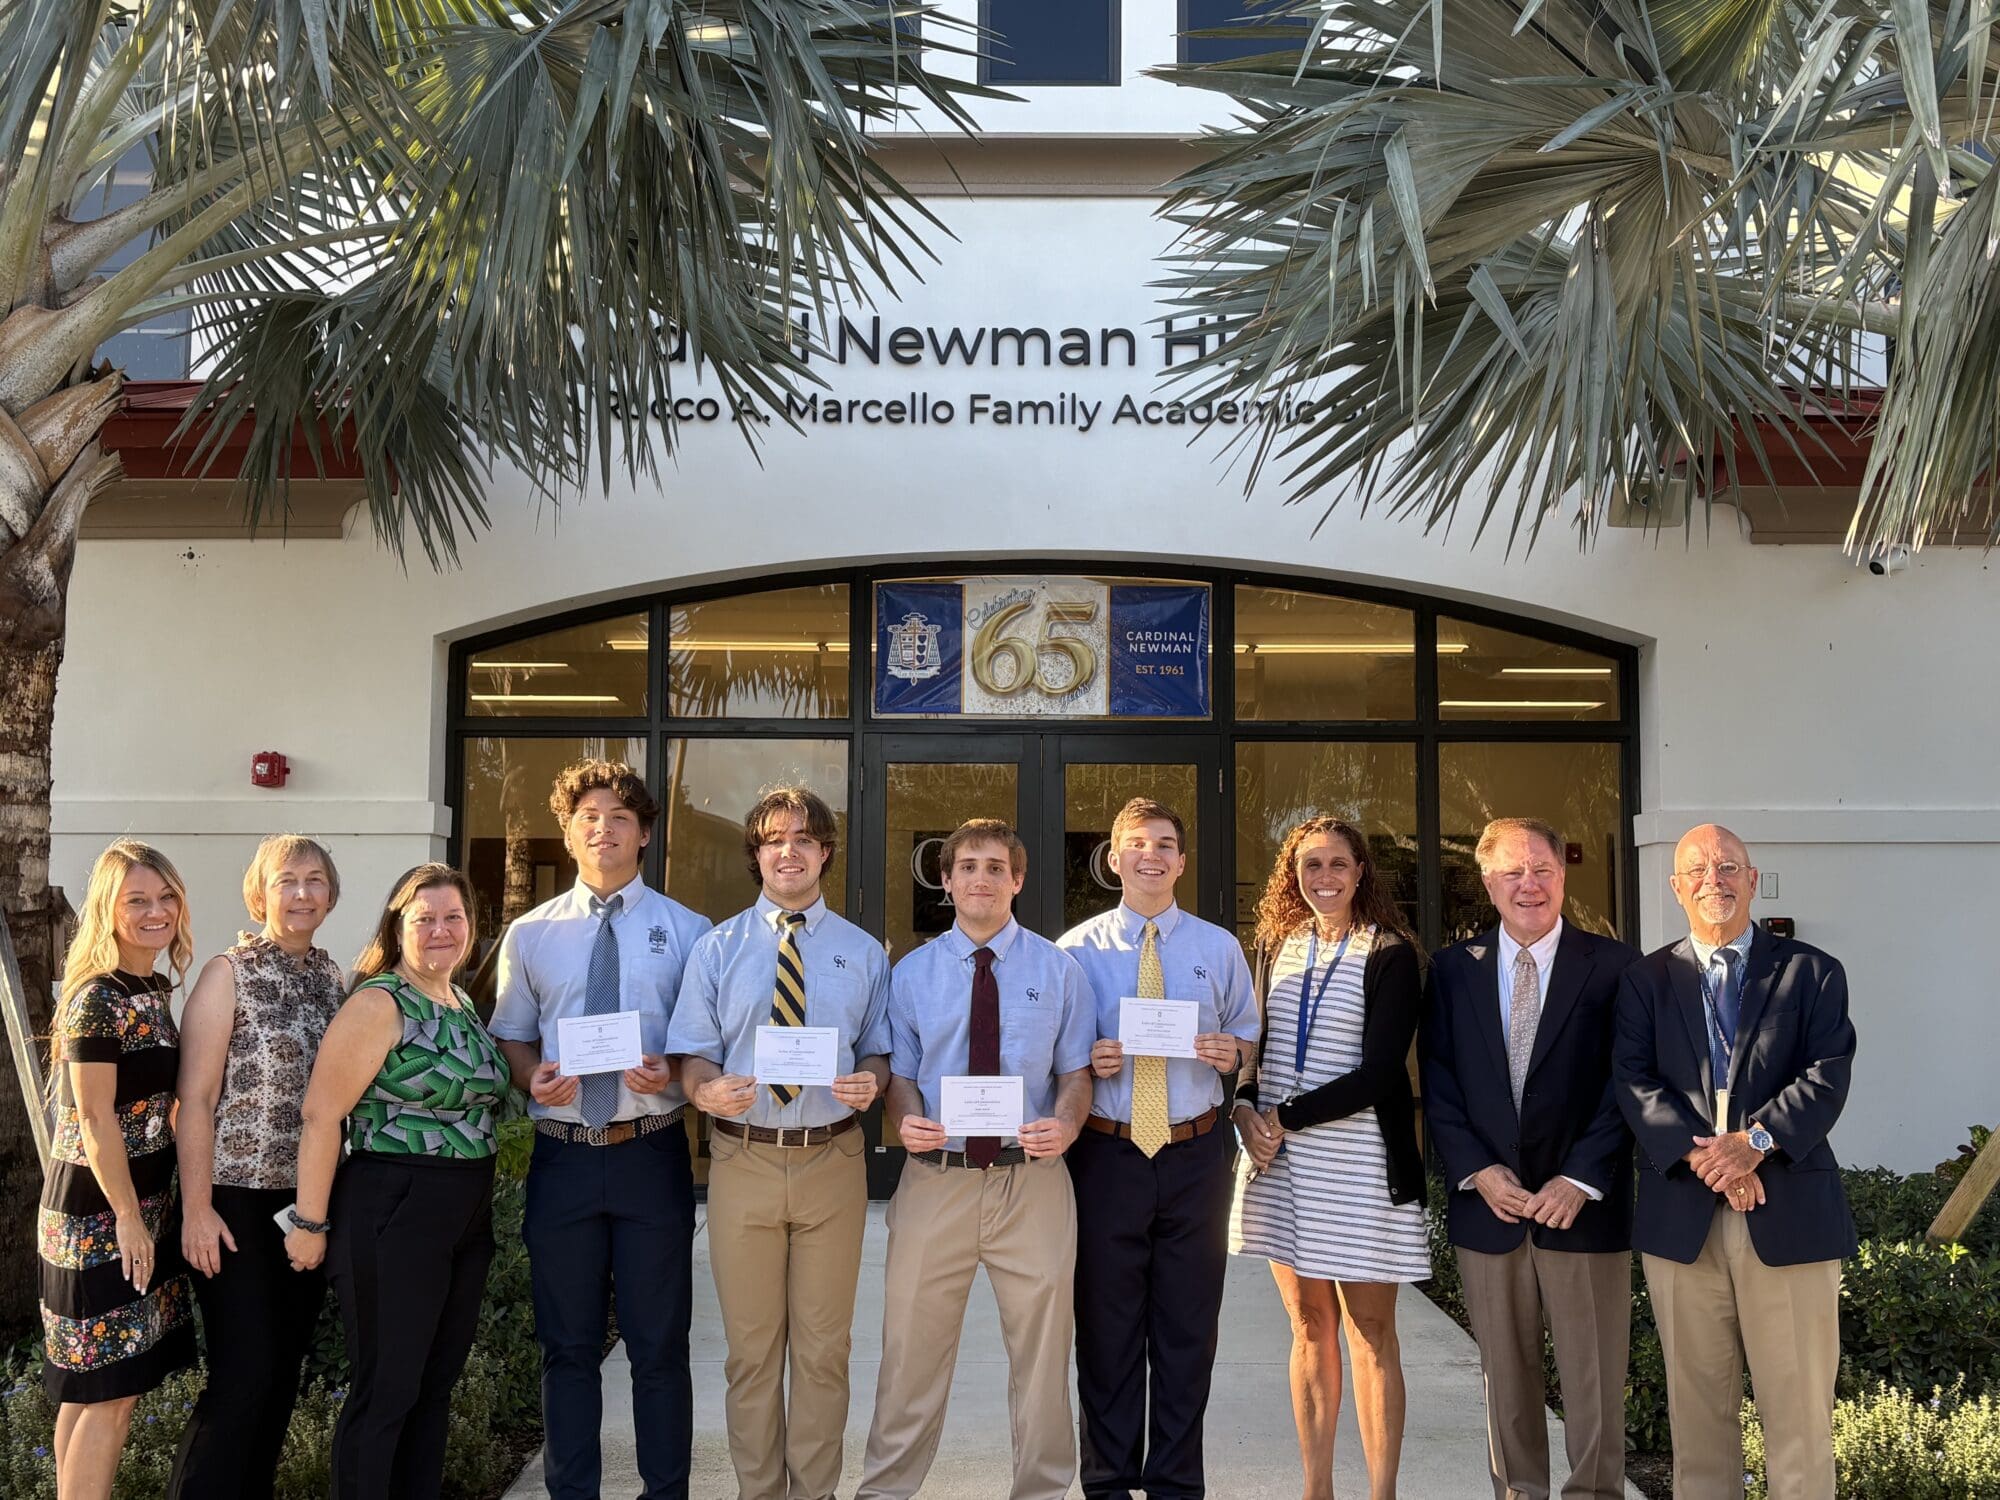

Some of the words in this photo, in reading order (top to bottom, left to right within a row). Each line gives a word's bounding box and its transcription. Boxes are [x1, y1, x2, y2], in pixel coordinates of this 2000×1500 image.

[837, 314, 1136, 367] Newman
[731, 392, 771, 424] A.
[786, 391, 955, 425] Marcello
[970, 392, 1102, 433] Family
[1112, 391, 1316, 426] Academic
[971, 600, 1098, 695] 65
[1126, 631, 1195, 642] CARDINAL
[1129, 643, 1192, 654] NEWMAN
[1135, 664, 1157, 675] EST.
[1159, 665, 1185, 676] 1961
